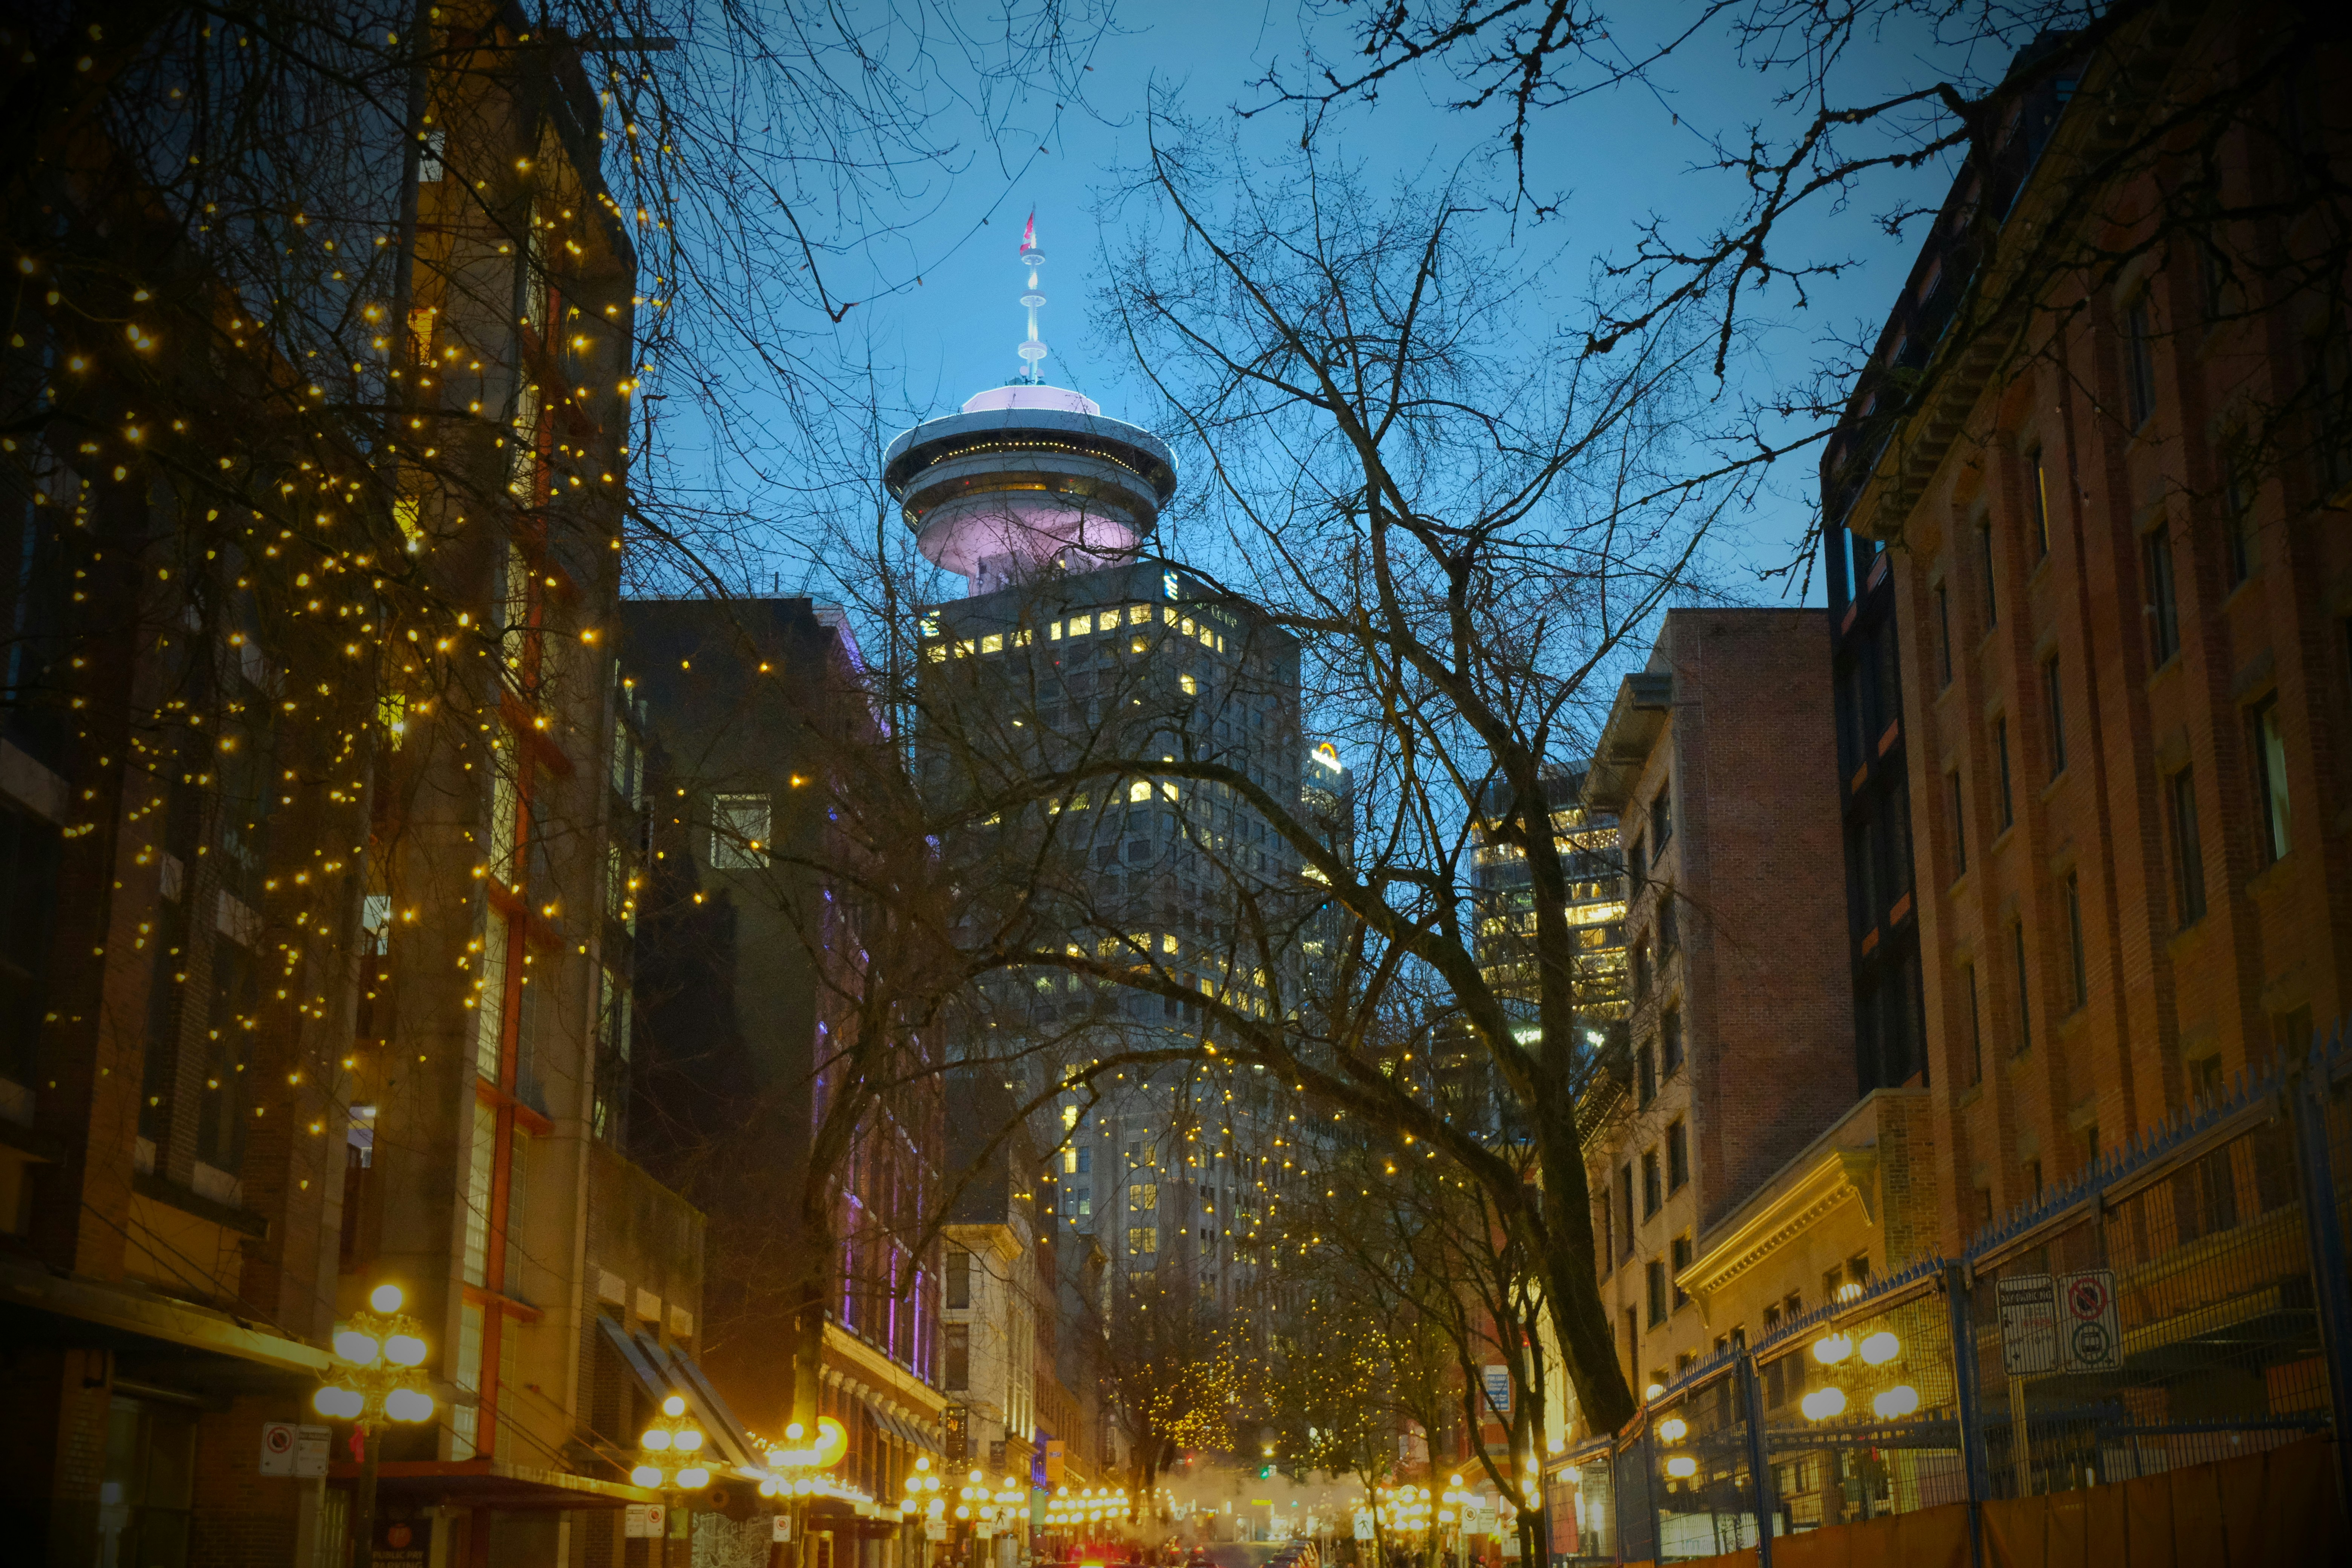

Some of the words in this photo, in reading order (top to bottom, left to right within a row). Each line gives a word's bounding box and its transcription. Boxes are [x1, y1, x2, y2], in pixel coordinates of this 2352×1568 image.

[2016, 1291, 2052, 1302] PARKNG
[372, 1551, 405, 1559] PUBLIC
[407, 1551, 424, 1559] PAY
